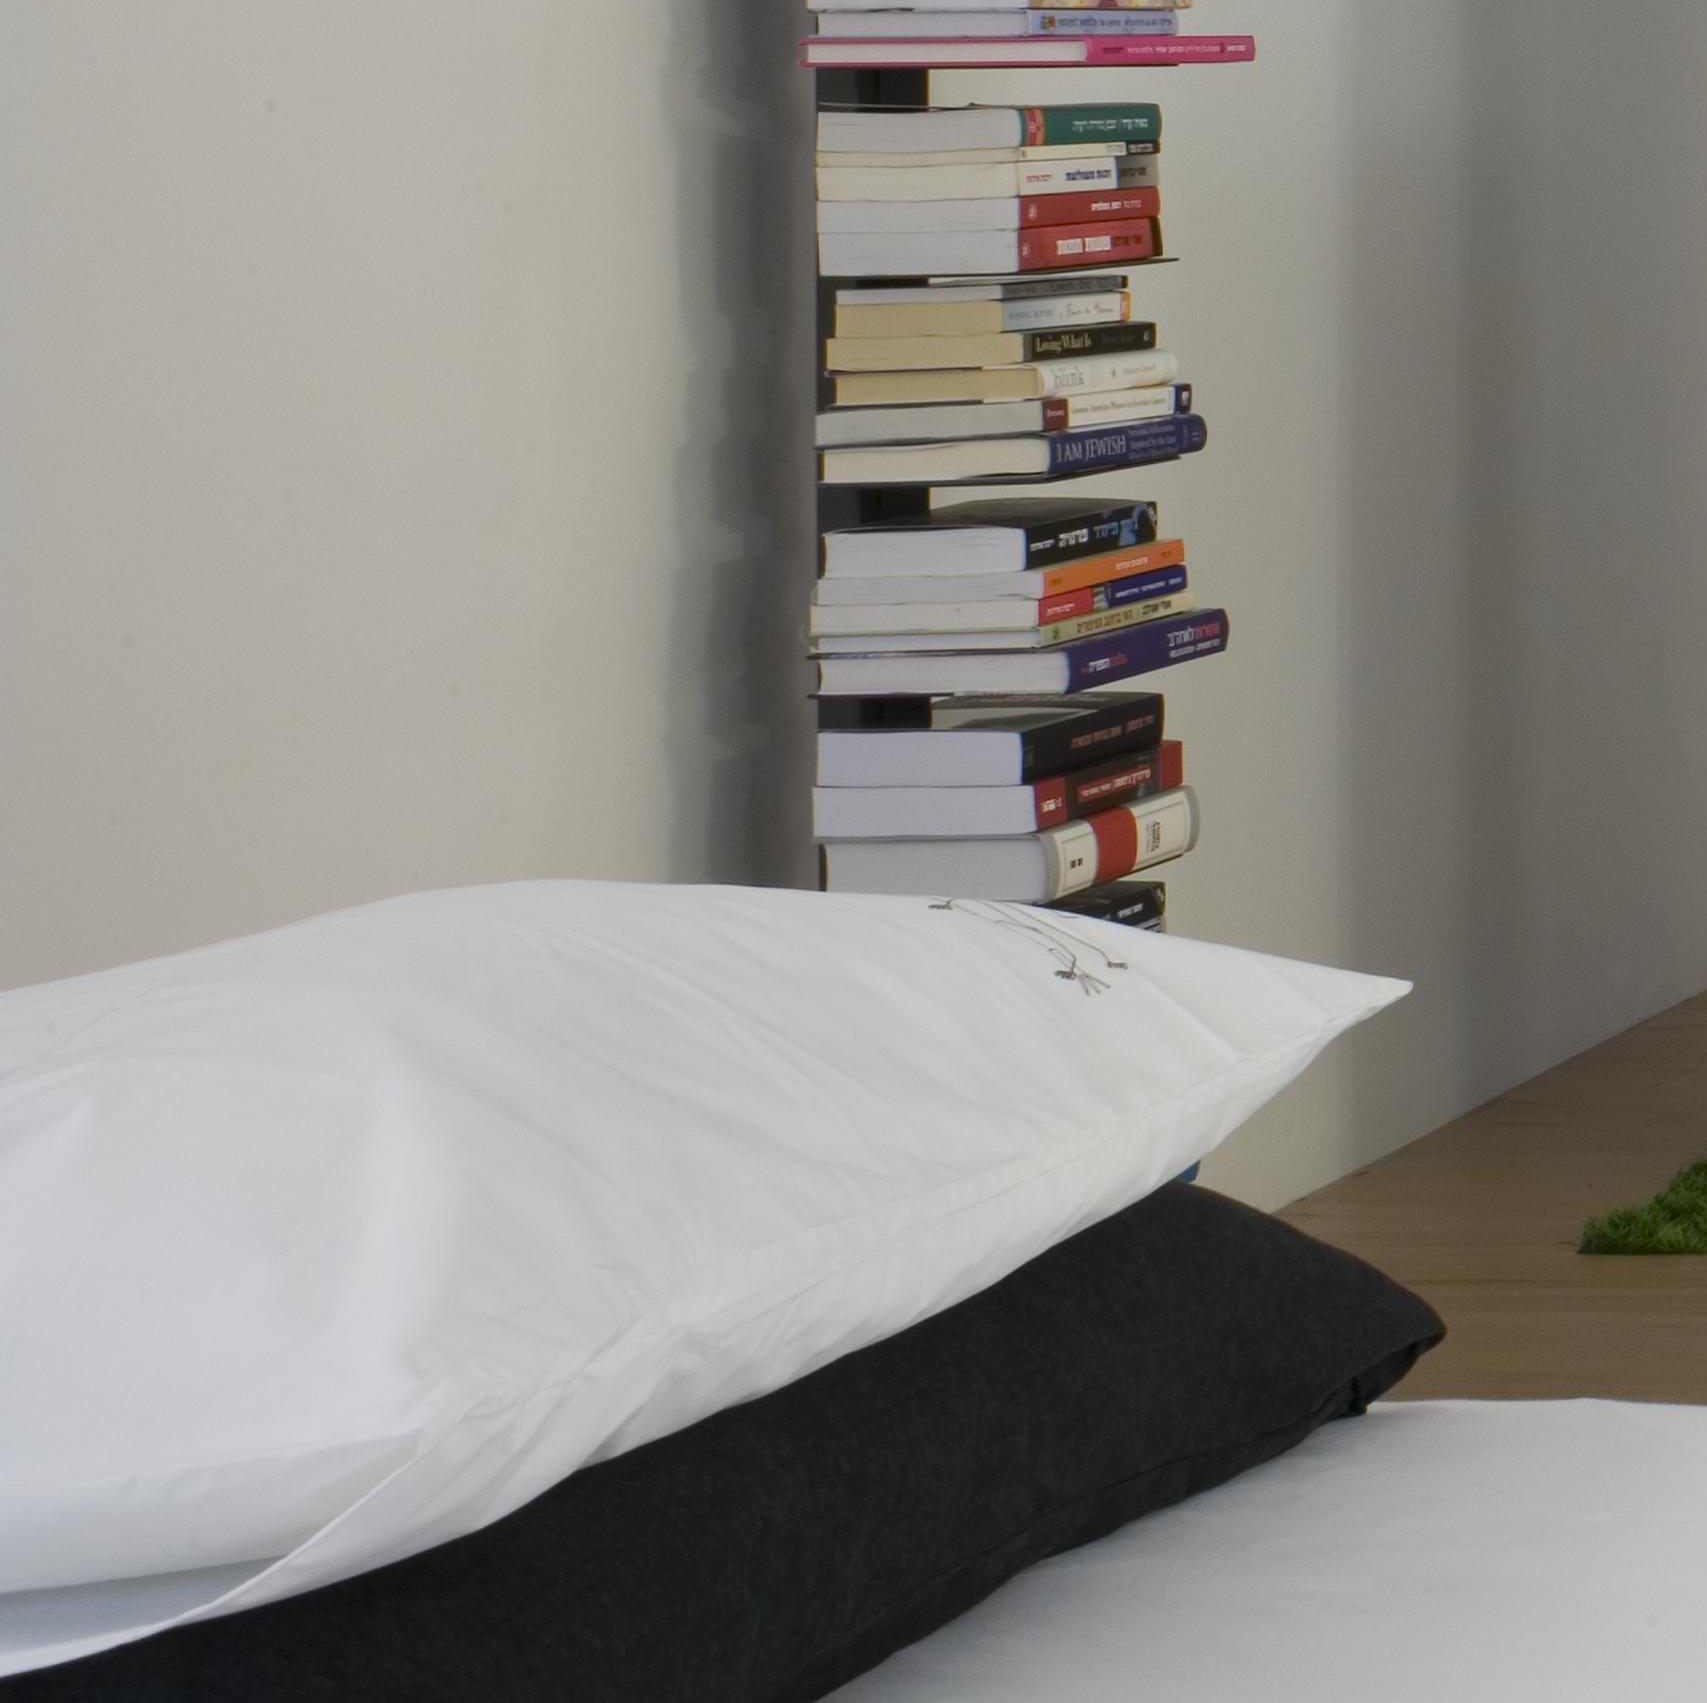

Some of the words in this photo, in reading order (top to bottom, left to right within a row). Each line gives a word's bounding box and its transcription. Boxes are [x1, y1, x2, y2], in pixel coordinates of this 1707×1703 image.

[1056, 443, 1062, 463] I
[1064, 441, 1083, 461] AM
[1083, 434, 1127, 461] JEWISH
